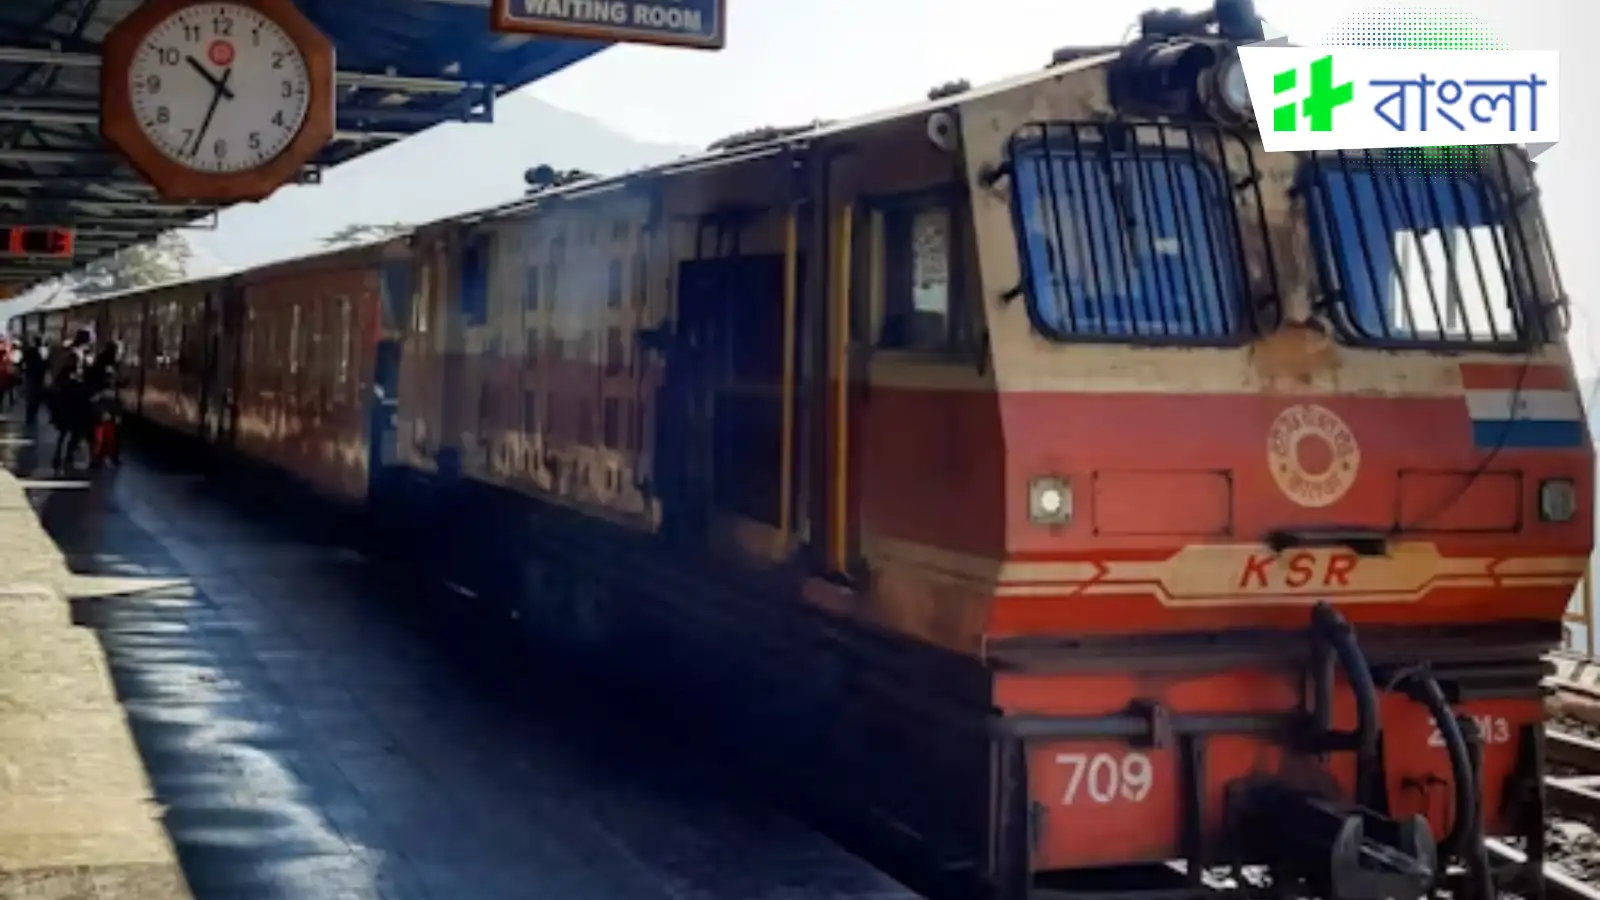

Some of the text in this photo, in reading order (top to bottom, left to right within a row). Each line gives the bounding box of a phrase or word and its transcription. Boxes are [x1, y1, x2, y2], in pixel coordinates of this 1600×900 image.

[523, 0, 702, 29] WAITING ROOM
[183, 25, 201, 42] 11
[212, 17, 234, 36] 12
[251, 29, 260, 46] 1
[158, 48, 180, 66] 10
[271, 51, 284, 69] 2
[147, 75, 161, 94] 9
[281, 81, 292, 98] 3
[157, 106, 170, 124] 8
[271, 110, 284, 127] 4
[182, 129, 195, 147] 7
[250, 132, 261, 149] 5
[213, 139, 227, 158] 6
[1239, 552, 1358, 588] KSR
[1055, 752, 1153, 805] 709
